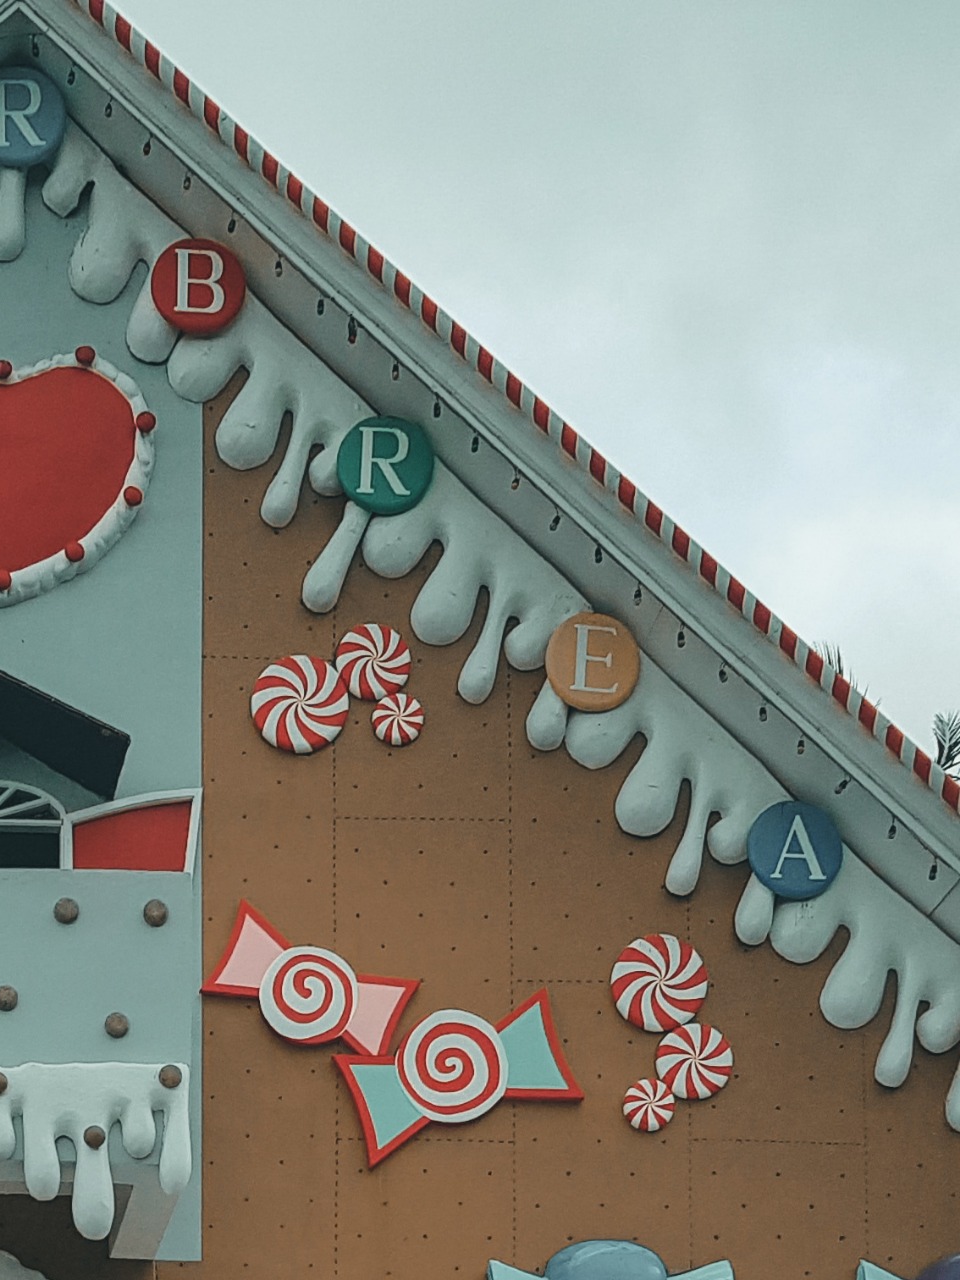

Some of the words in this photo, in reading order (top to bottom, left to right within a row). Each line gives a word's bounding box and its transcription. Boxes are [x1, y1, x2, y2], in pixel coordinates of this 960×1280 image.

[173, 248, 226, 314] B
[356, 426, 411, 496] R
[569, 623, 619, 695] E
[770, 814, 827, 881] A
